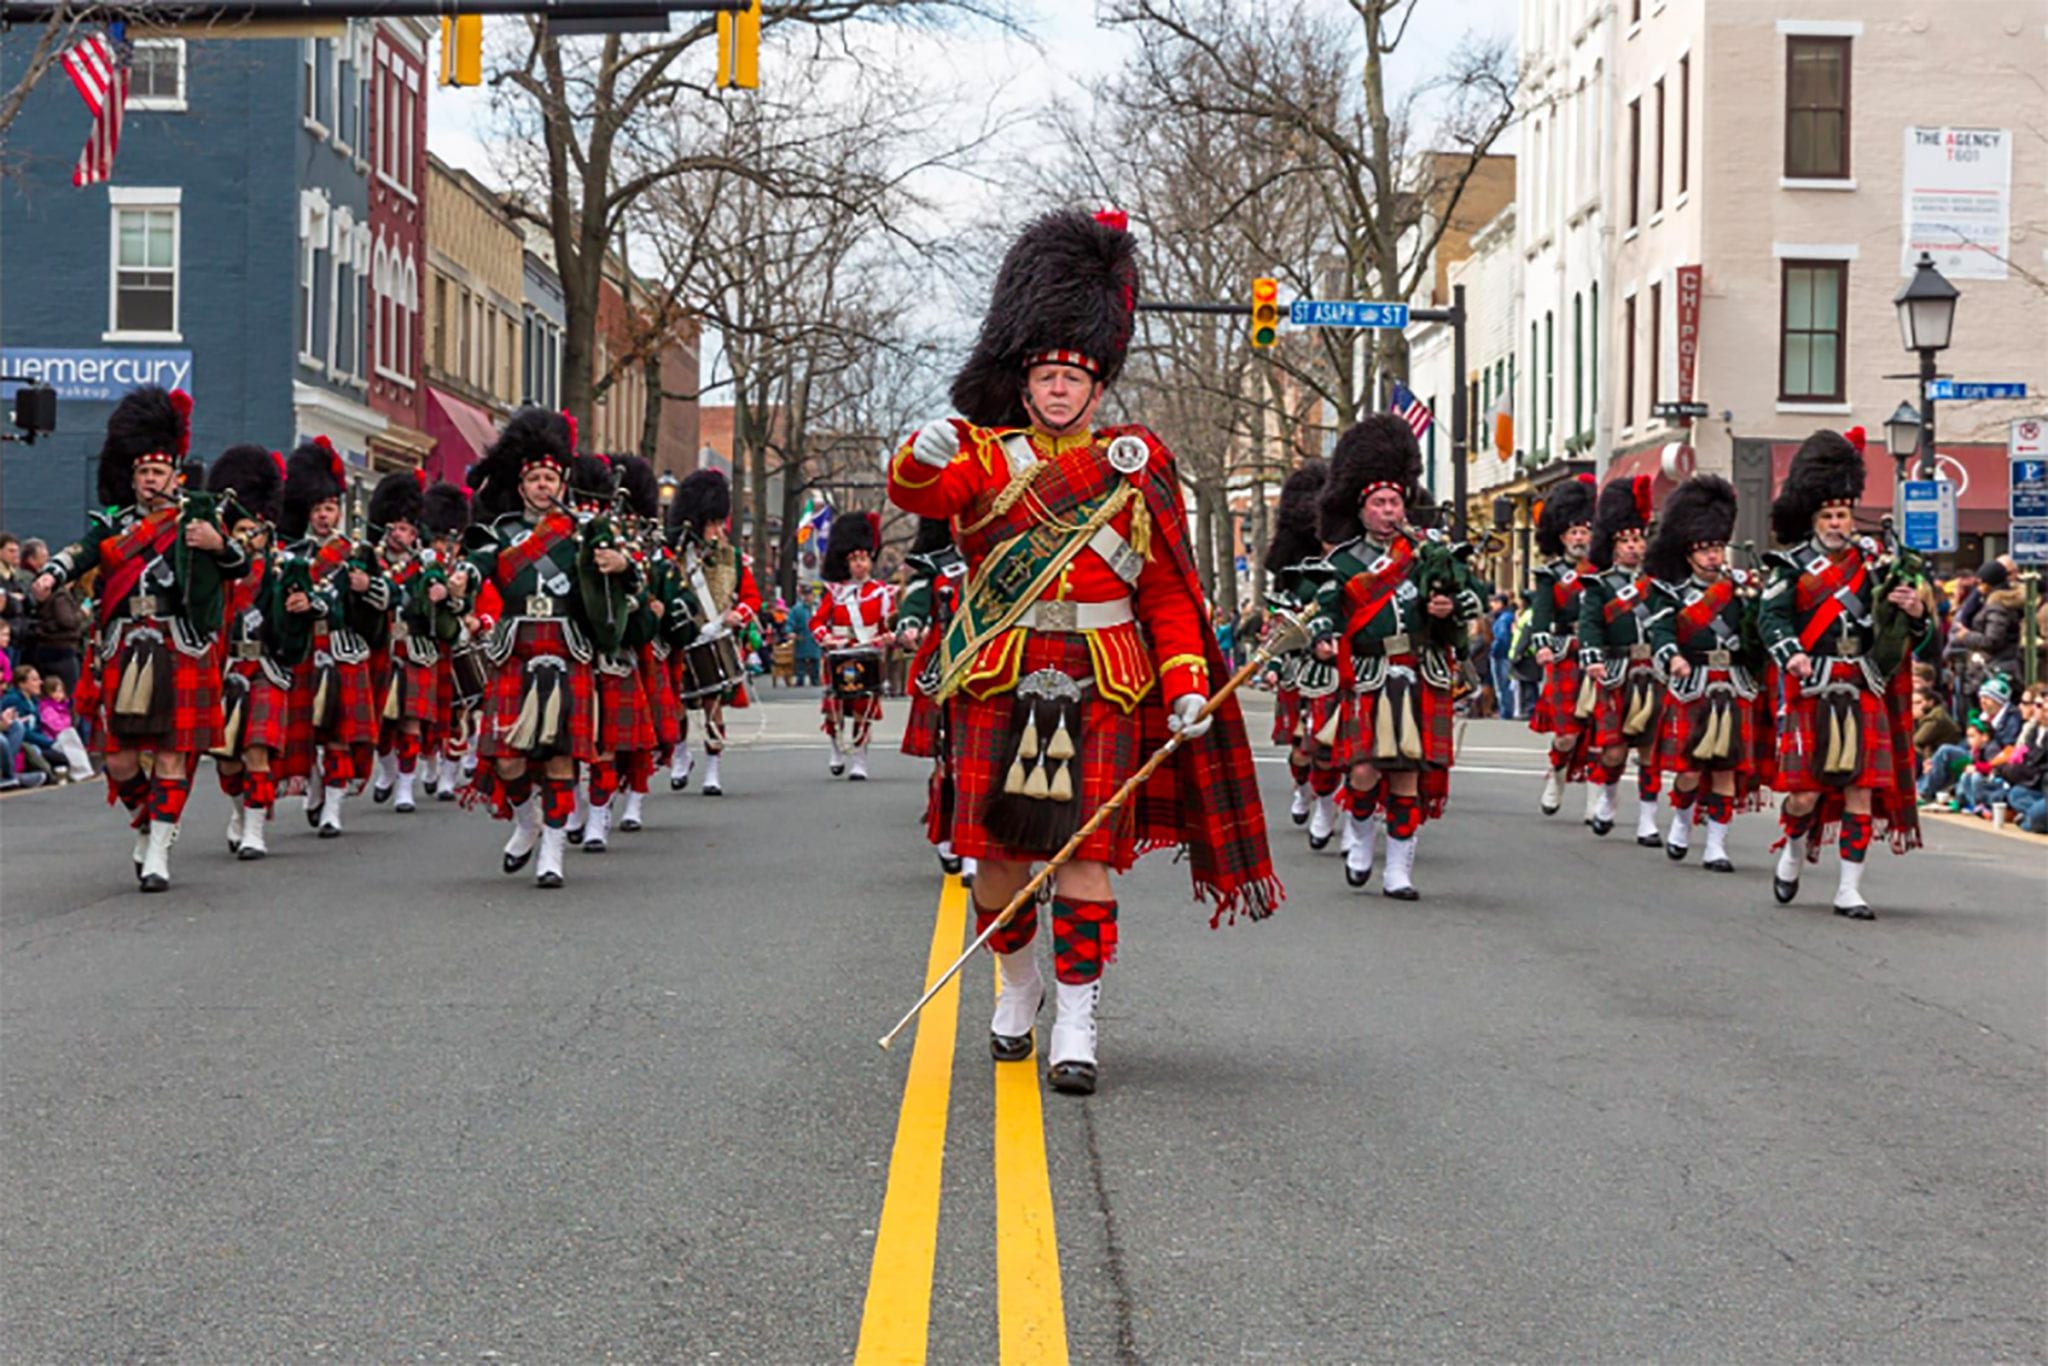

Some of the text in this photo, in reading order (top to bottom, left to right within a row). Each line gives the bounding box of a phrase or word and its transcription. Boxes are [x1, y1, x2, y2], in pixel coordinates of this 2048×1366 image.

[1915, 131, 2000, 147] THE AGENCY
[1294, 303, 1309, 322] ST
[1382, 306, 1402, 325] ST
[1680, 272, 1697, 398] CHIPOTLE
